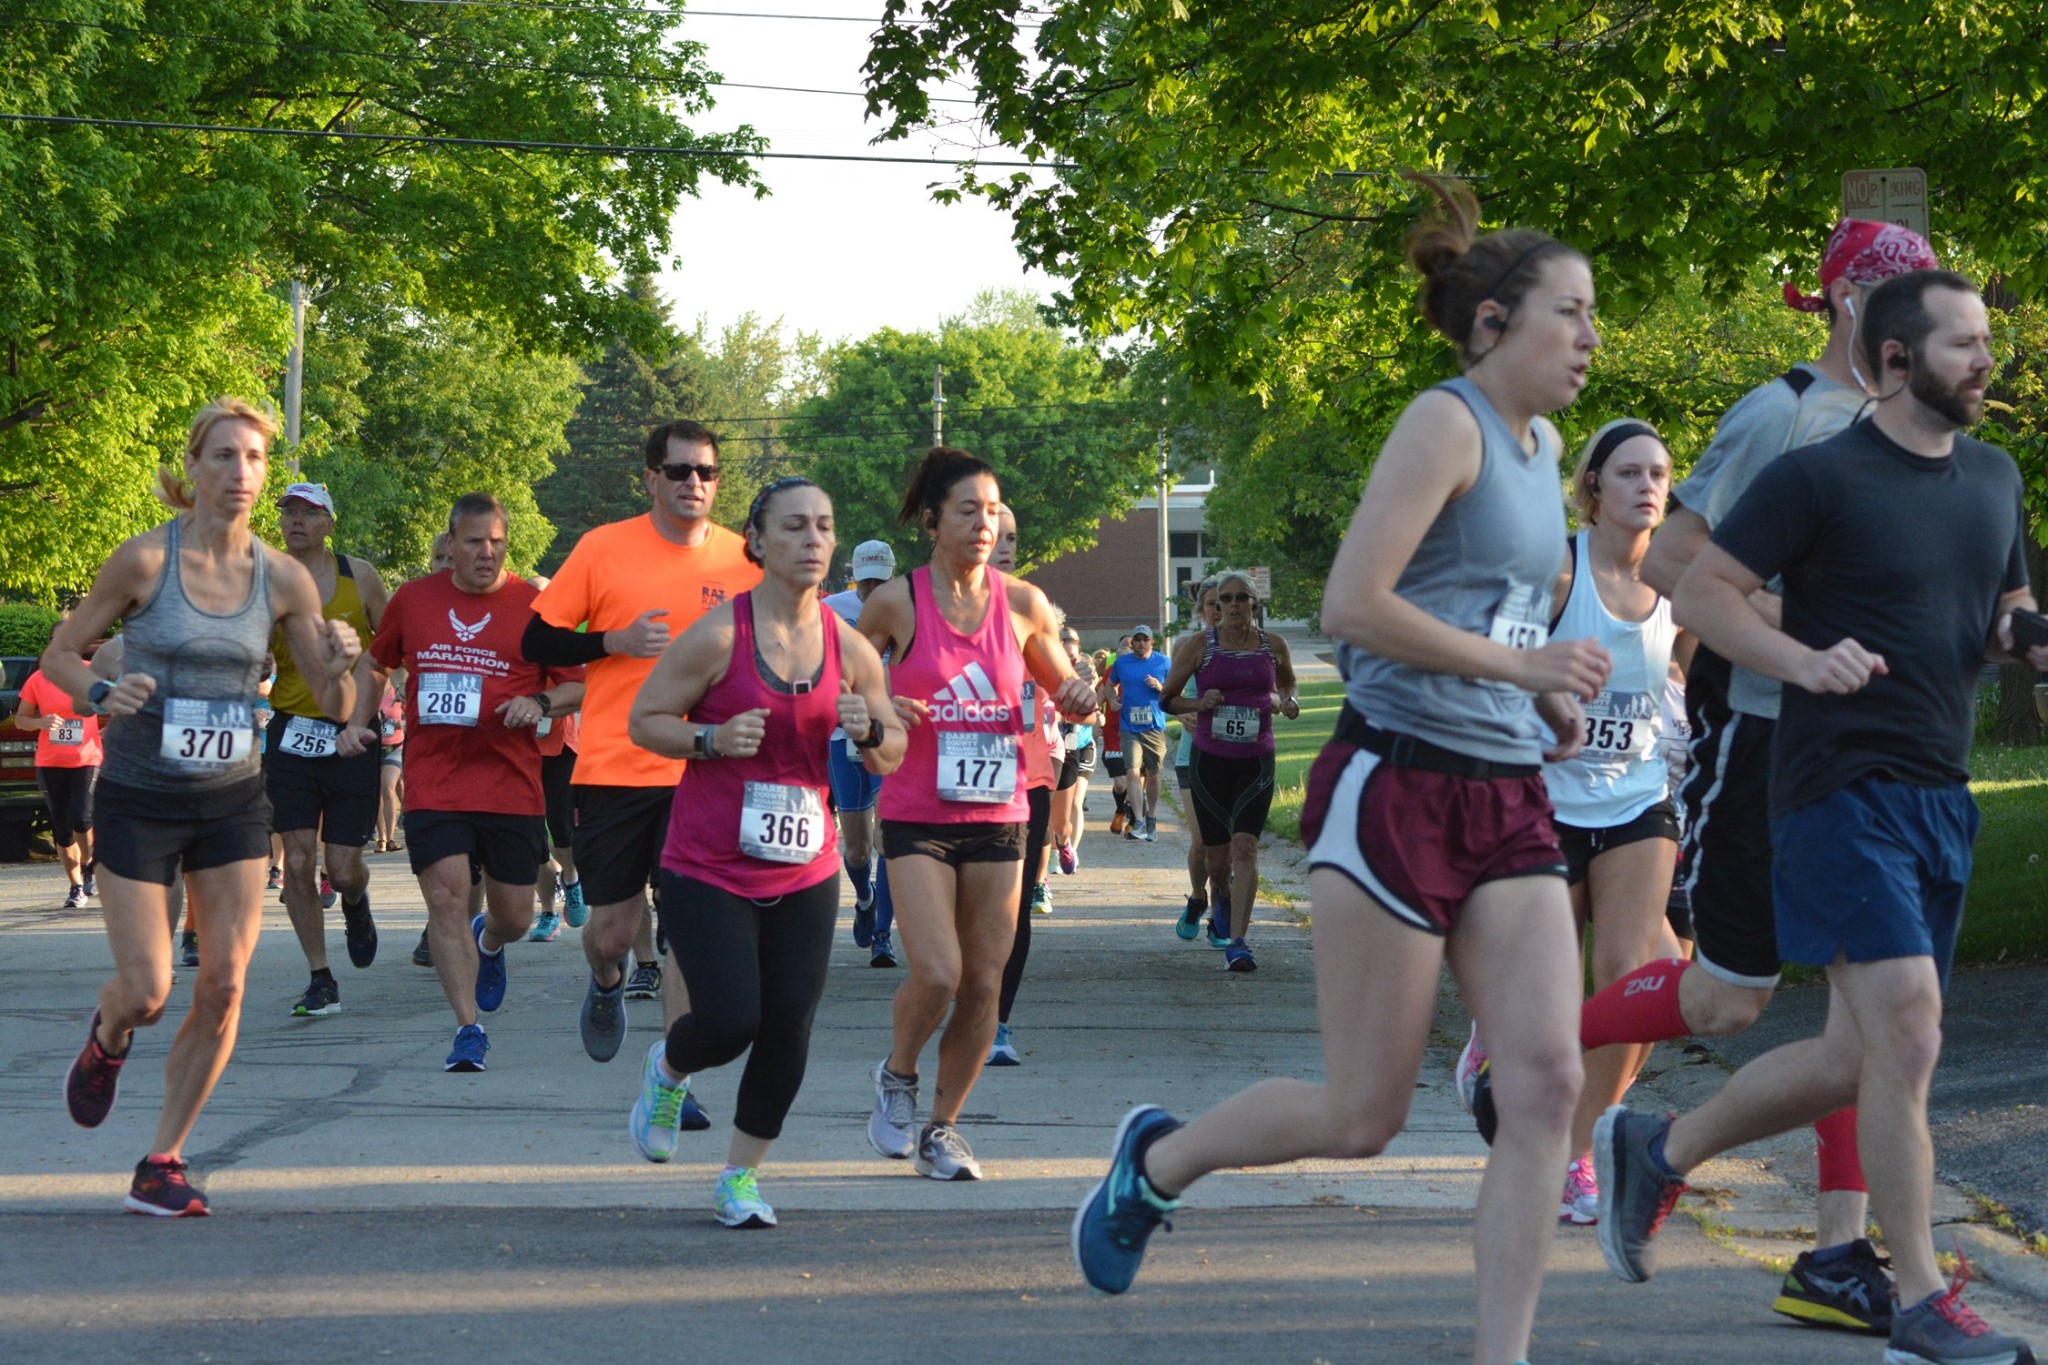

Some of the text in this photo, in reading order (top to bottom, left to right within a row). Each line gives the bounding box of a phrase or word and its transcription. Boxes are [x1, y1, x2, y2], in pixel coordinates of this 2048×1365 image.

[1870, 181, 1921, 198] PKING
[417, 651, 510, 671] MARATHON
[430, 643, 497, 658] AIR FORCE
[427, 692, 467, 714] 286
[928, 699, 1010, 722] adidas
[58, 728, 73, 740] 83
[945, 732, 978, 740] DARKE
[1226, 719, 1246, 736] 65
[1582, 717, 1633, 751] 353
[180, 728, 234, 760] 370
[291, 732, 327, 754] 256
[956, 758, 1002, 788] 177
[759, 812, 810, 848] 366
